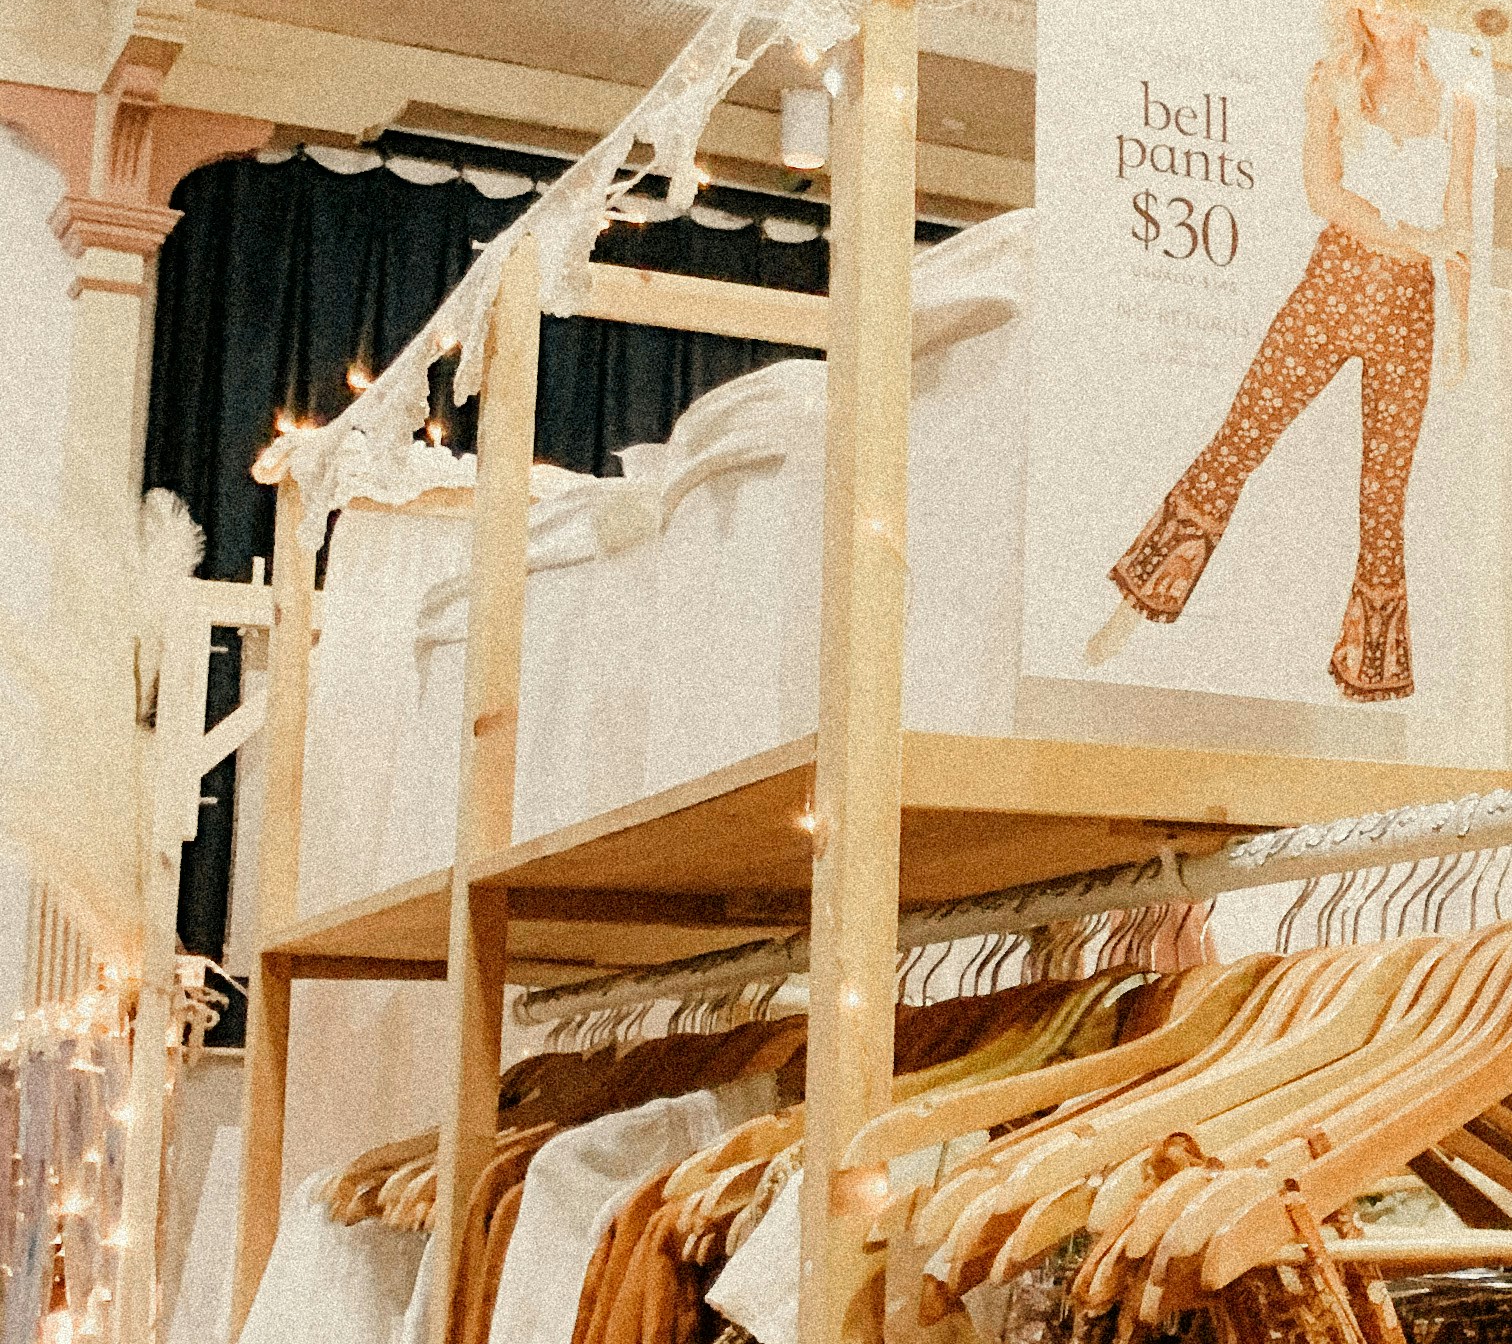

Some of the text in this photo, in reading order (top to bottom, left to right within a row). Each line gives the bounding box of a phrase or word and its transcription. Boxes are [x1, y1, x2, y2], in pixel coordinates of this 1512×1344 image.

[1141, 80, 1228, 144] bell
[1115, 134, 1255, 190] pants
[1131, 188, 1239, 267] $30
